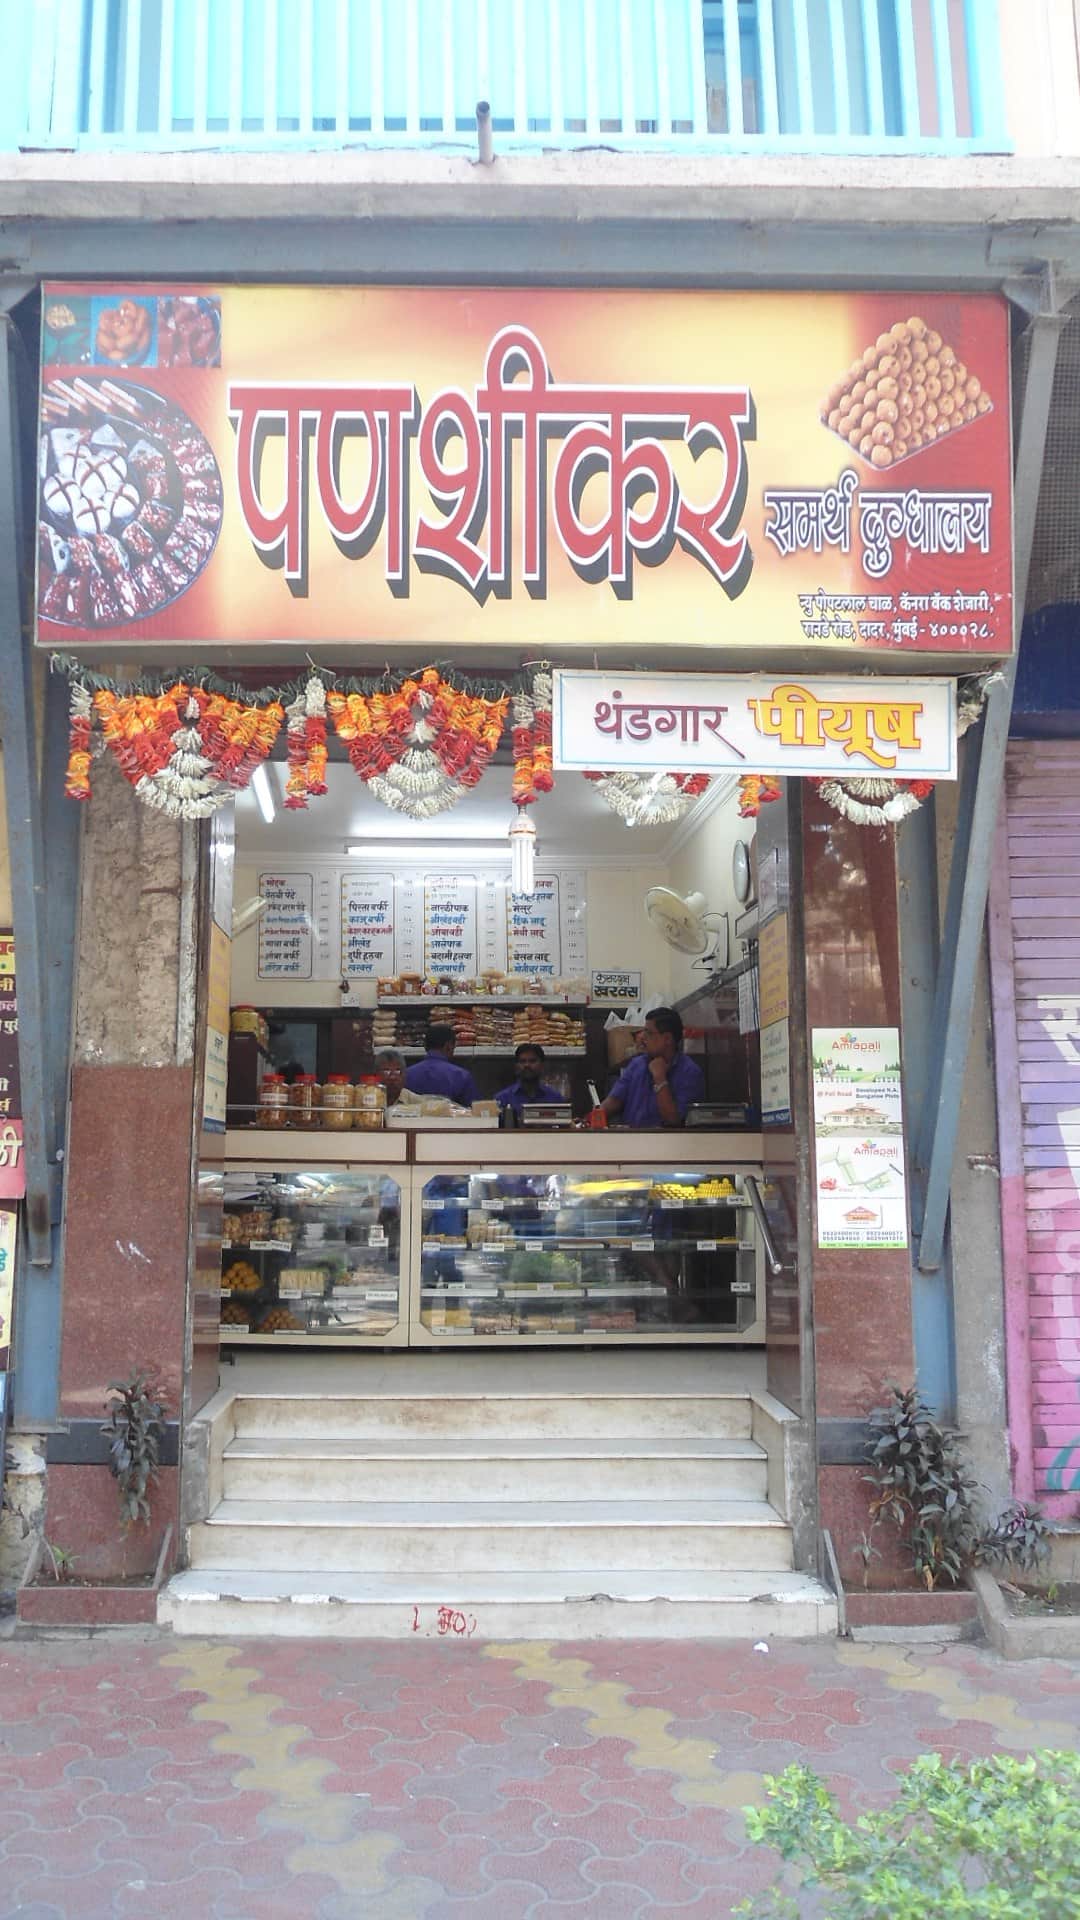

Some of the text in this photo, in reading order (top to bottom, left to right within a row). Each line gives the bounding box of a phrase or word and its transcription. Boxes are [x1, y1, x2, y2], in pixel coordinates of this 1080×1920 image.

[229, 324, 756, 600] पणशीकर
[764, 469, 992, 578] समर्थ दुग्धालय
[815, 587, 866, 612] पोपटलाल
[801, 614, 830, 638] रानडे
[593, 684, 924, 769] थंडगार पीयूष
[594, 985, 638, 998] खरवस
[832, 1039, 881, 1052] Amrapali
